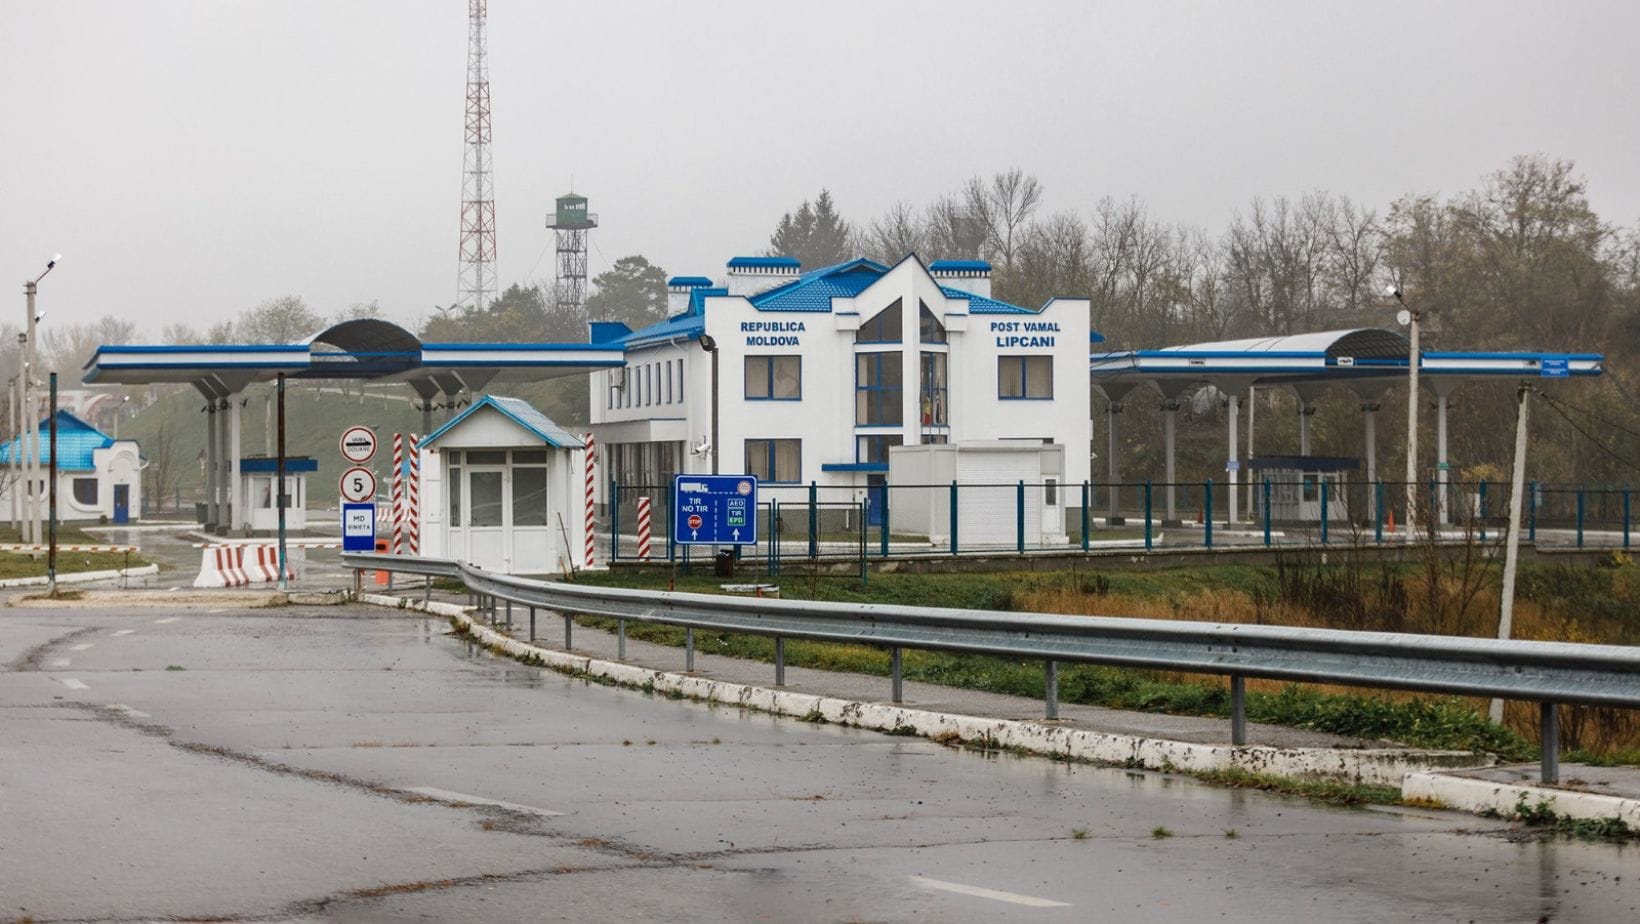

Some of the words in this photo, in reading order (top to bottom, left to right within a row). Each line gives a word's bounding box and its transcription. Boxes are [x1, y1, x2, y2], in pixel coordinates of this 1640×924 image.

[741, 322, 805, 332] REPUBLICA
[991, 322, 1020, 332] POST
[1024, 322, 1060, 332] VAMAL
[746, 336, 800, 346] MOLDOVA
[997, 336, 1055, 347] LIPCANI
[353, 478, 363, 493] 5
